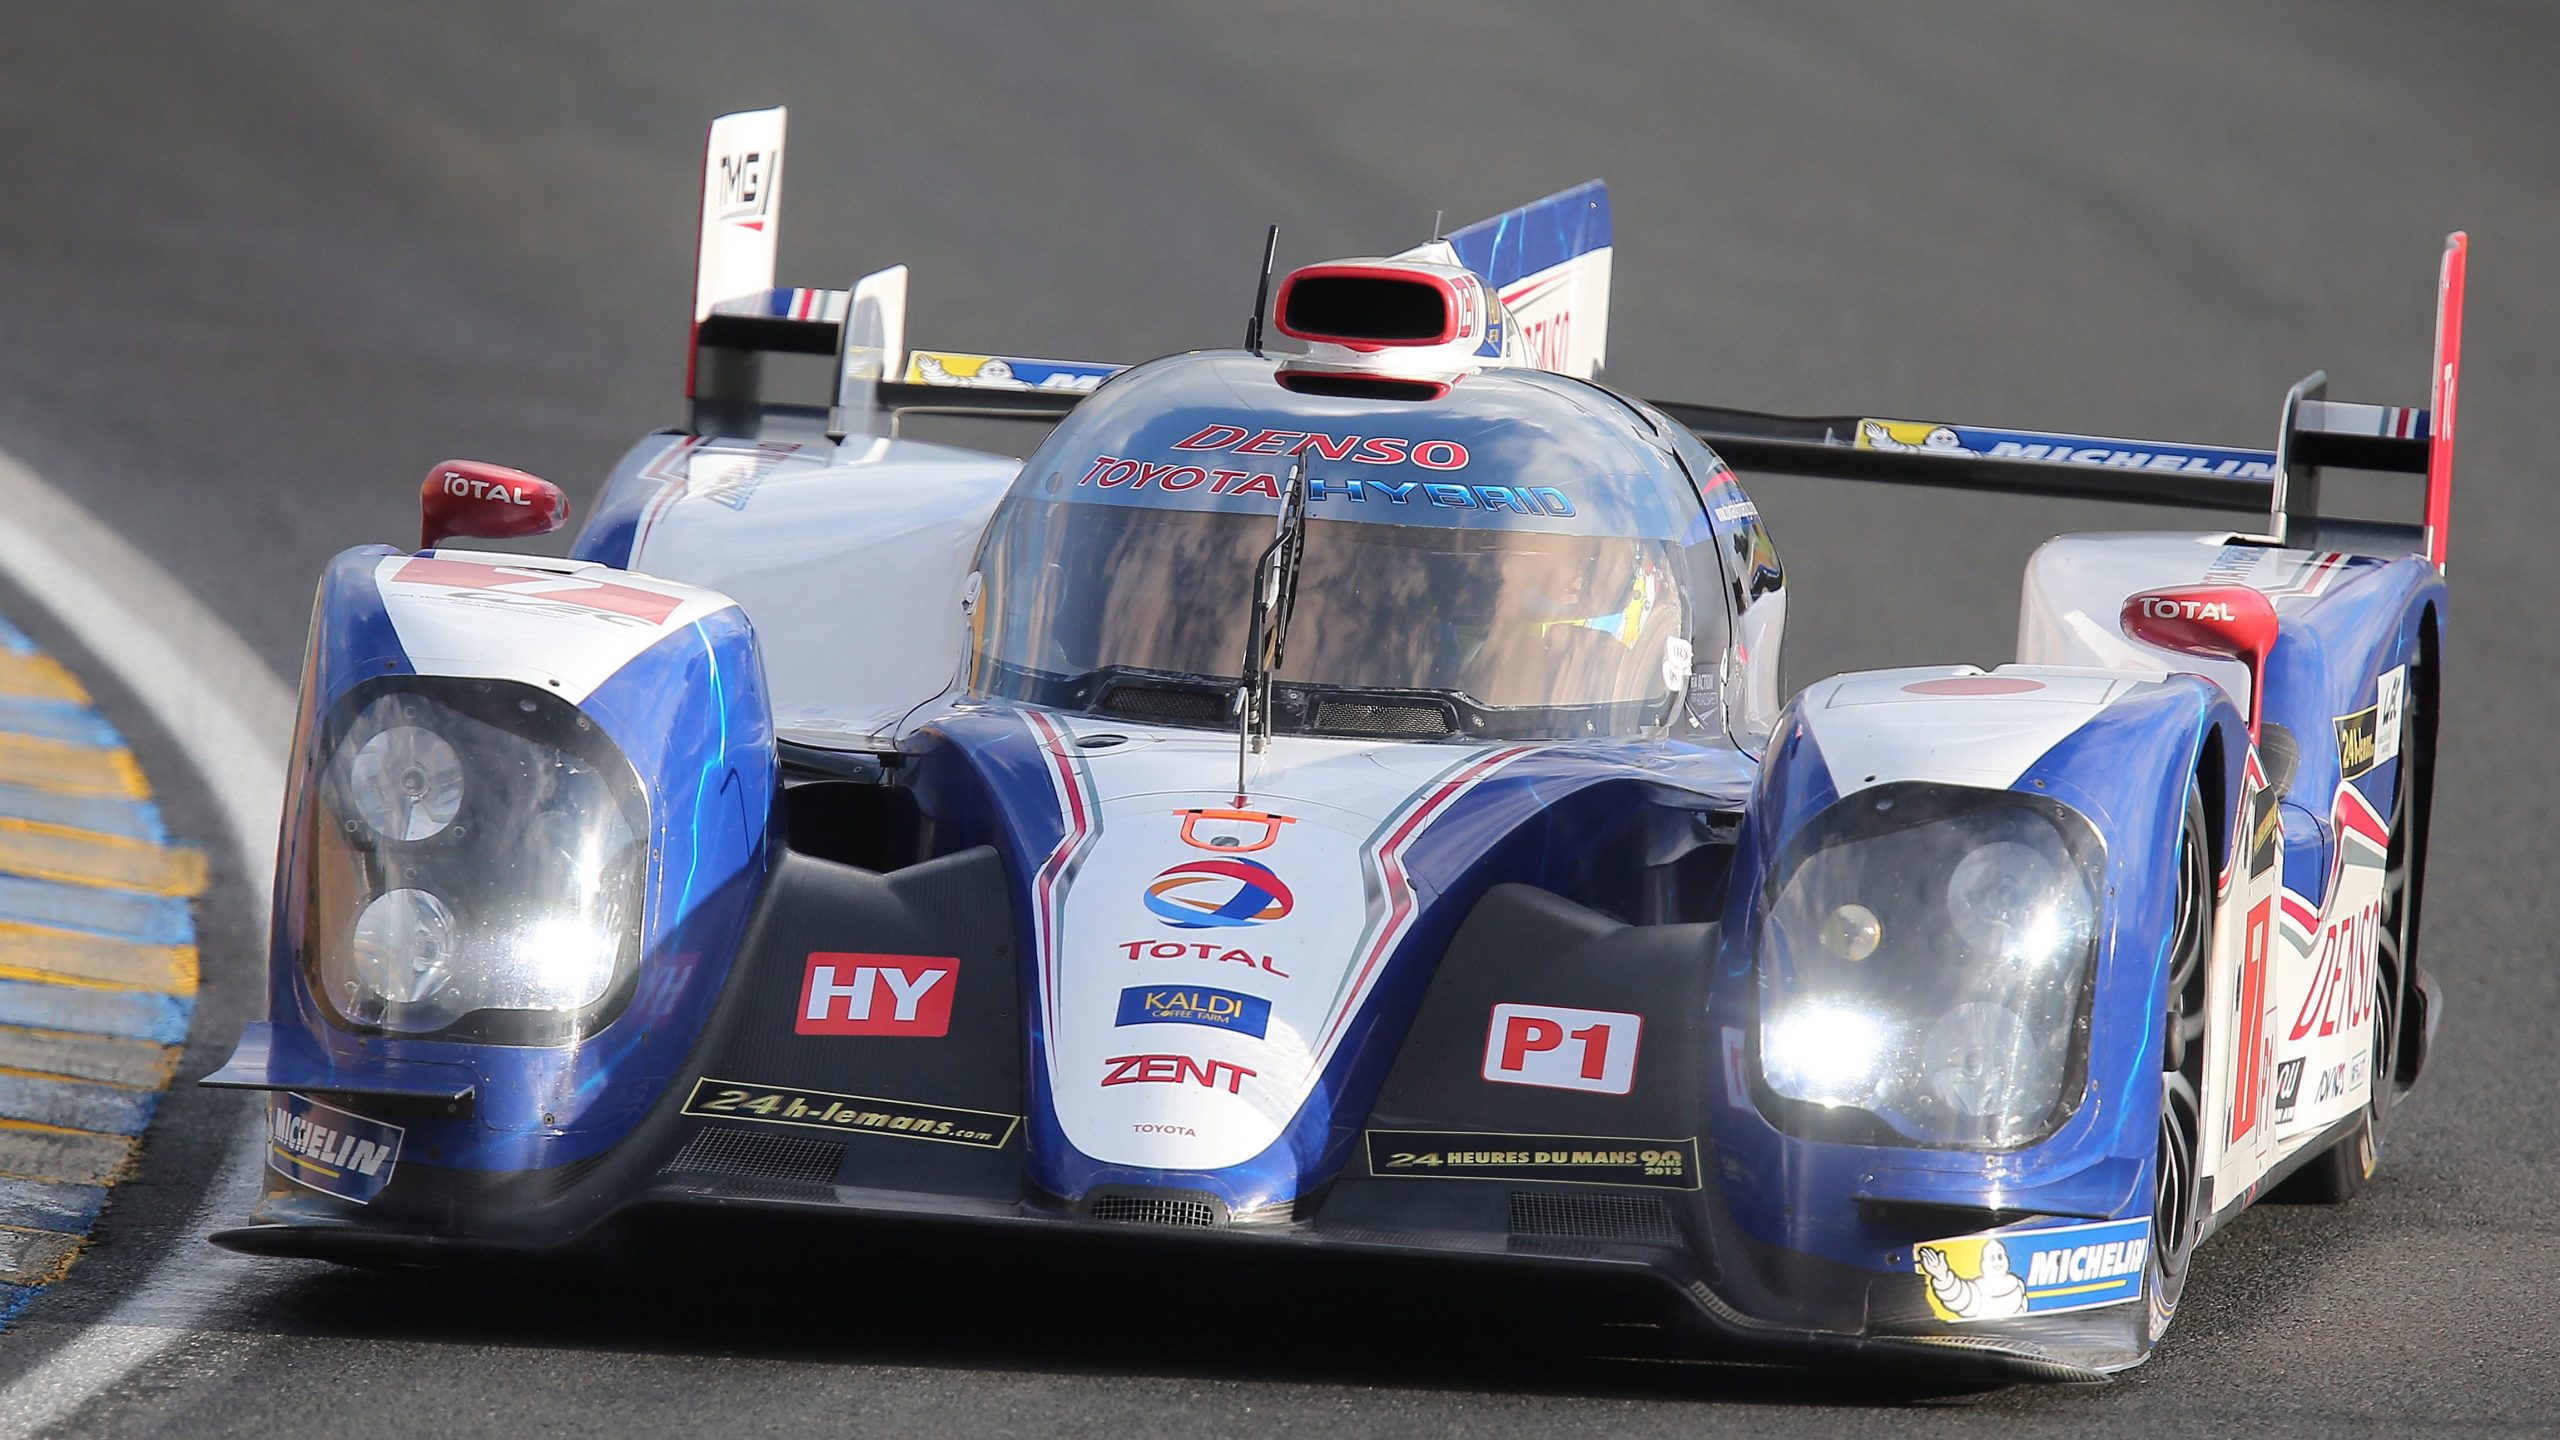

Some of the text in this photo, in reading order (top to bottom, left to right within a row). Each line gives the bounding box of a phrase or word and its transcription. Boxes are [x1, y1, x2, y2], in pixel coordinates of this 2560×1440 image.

[1170, 423, 1470, 472] DENSO
[1987, 441, 2277, 479] MICHELIN
[443, 471, 531, 506] TOTAL
[1077, 454, 1577, 519] TOYOTA HYBRID
[2139, 597, 2236, 622] TOTAL
[1119, 940, 1290, 979] TOTAL
[2289, 900, 2379, 1041] DENSO
[806, 965, 948, 1021] HY
[1144, 991, 1243, 1018] KALDI
[1152, 1009, 1230, 1024] COFFEE FARM
[1500, 1015, 1613, 1081] P1
[1101, 1054, 1257, 1094] ZENT
[273, 1107, 391, 1176] MICHELIN
[1133, 1124, 1196, 1137] TOYOTA
[1386, 1152, 1444, 1168] 24
[1447, 1151, 1531, 1164] HEURES
[1534, 1152, 1570, 1164] DU
[1571, 1151, 1637, 1165] MANS
[1644, 1166, 1682, 1176] 2013
[2026, 1238, 2147, 1286] MICHELIN
